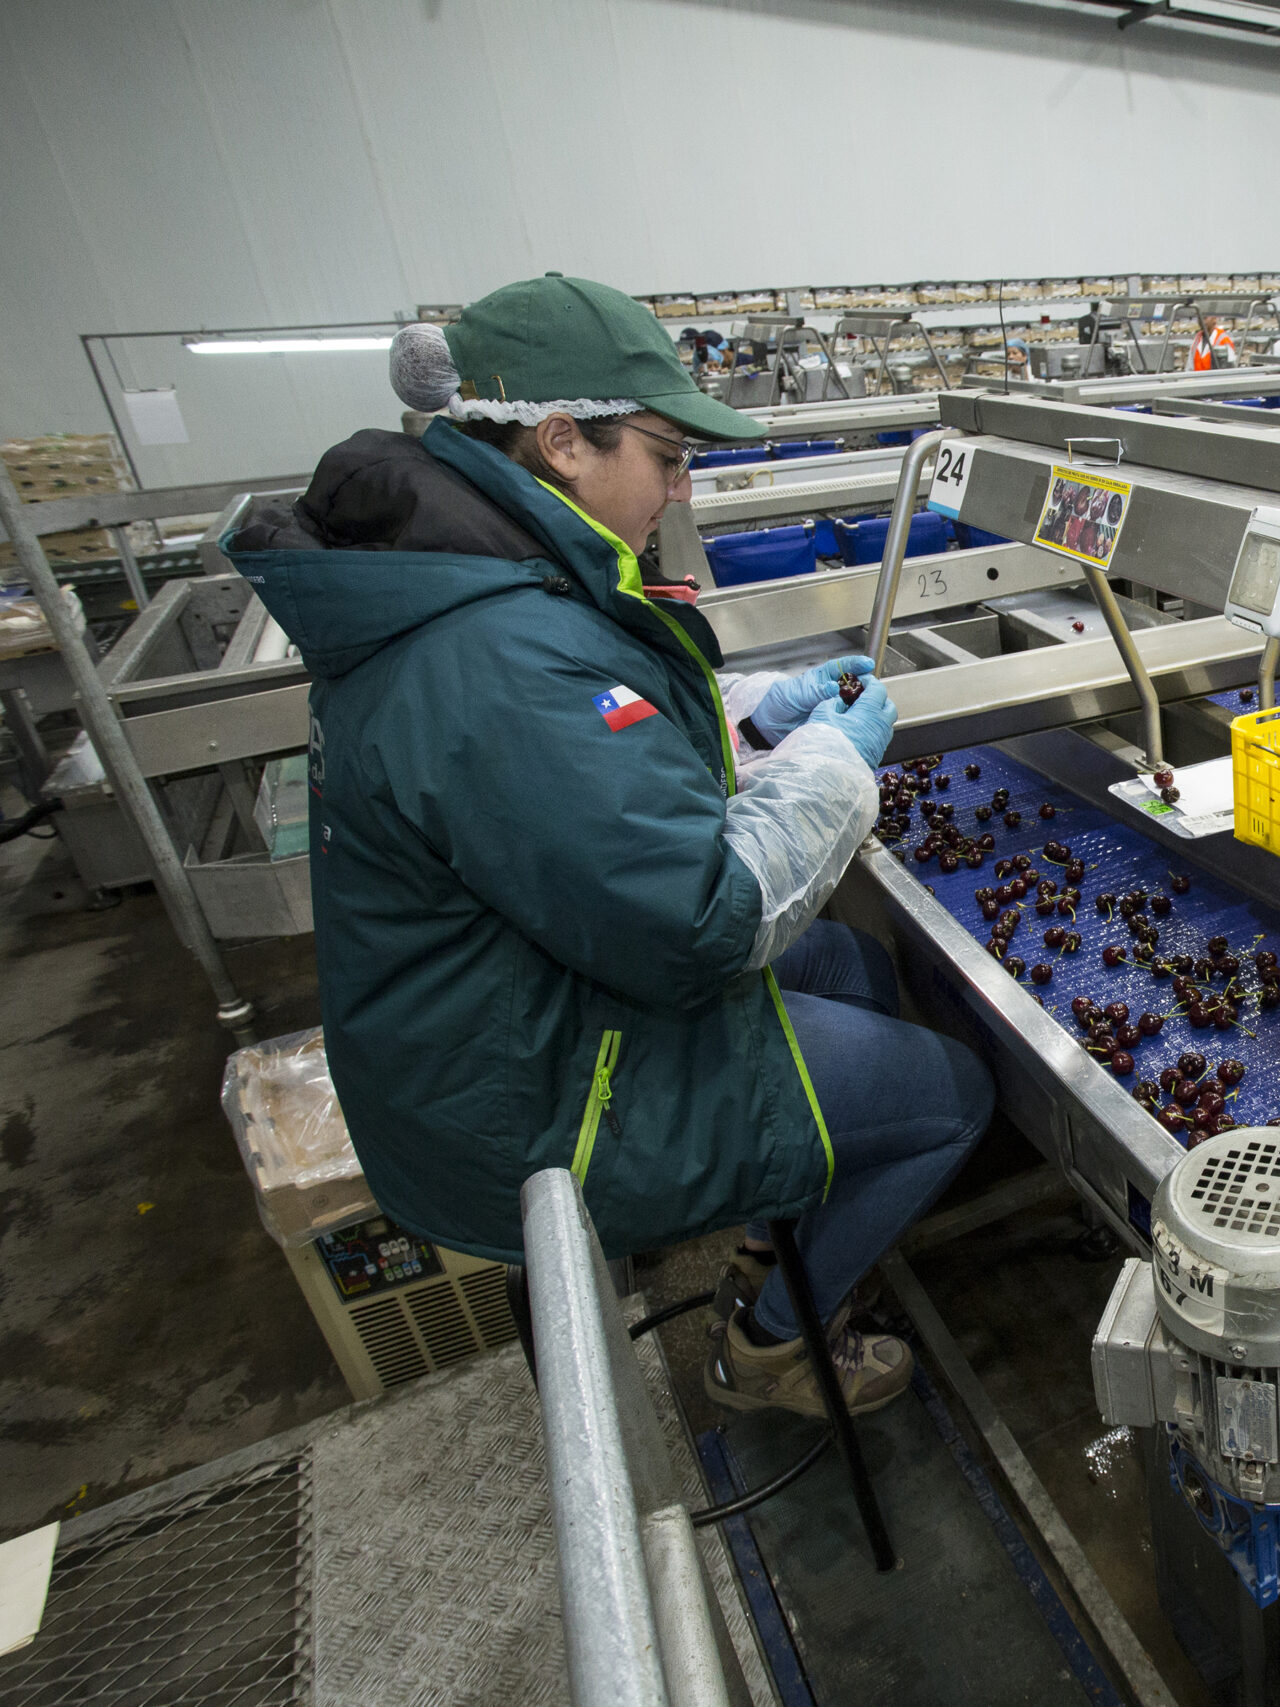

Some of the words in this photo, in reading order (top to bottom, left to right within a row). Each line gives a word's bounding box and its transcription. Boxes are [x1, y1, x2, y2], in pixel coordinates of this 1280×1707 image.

[936, 448, 966, 487] 24
[917, 569, 947, 598] 23
[1189, 1265, 1215, 1298] M
